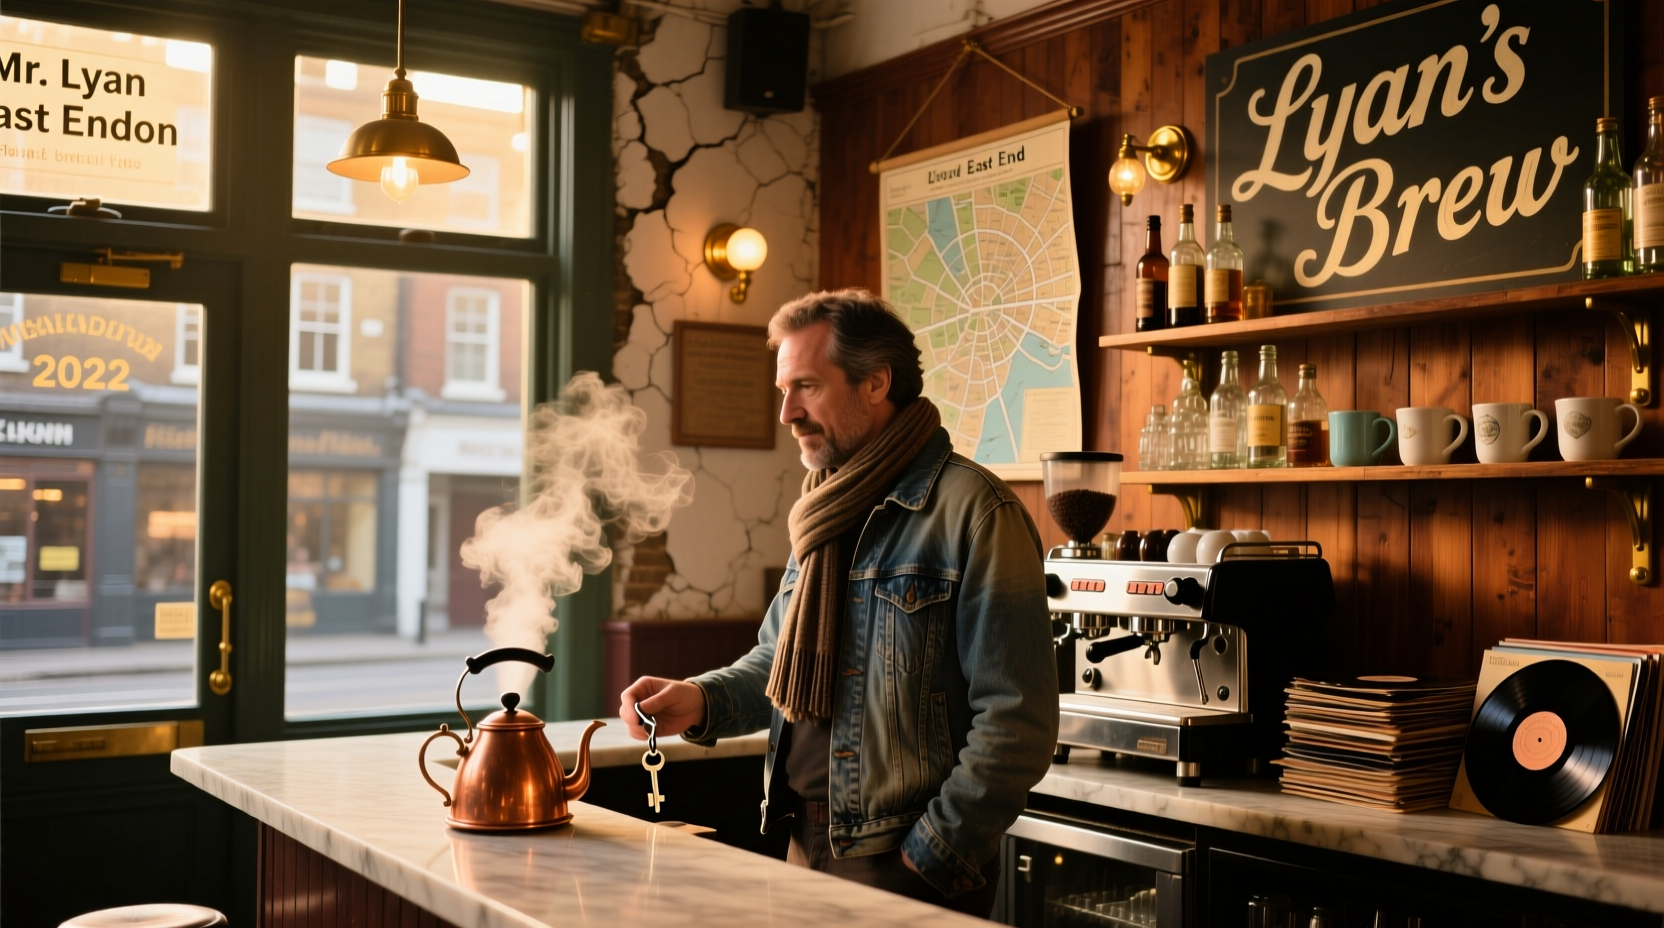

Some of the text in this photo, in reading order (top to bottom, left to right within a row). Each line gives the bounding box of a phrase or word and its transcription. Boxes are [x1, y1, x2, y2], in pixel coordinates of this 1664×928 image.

[0, 52, 146, 100] Mr. Lyan
[62, 104, 178, 147] Endon
[1232, 4, 1531, 202] Lyan's
[967, 155, 993, 175] East
[998, 145, 1025, 167] End
[1294, 136, 1580, 288] Brew
[32, 354, 130, 392] 2022
